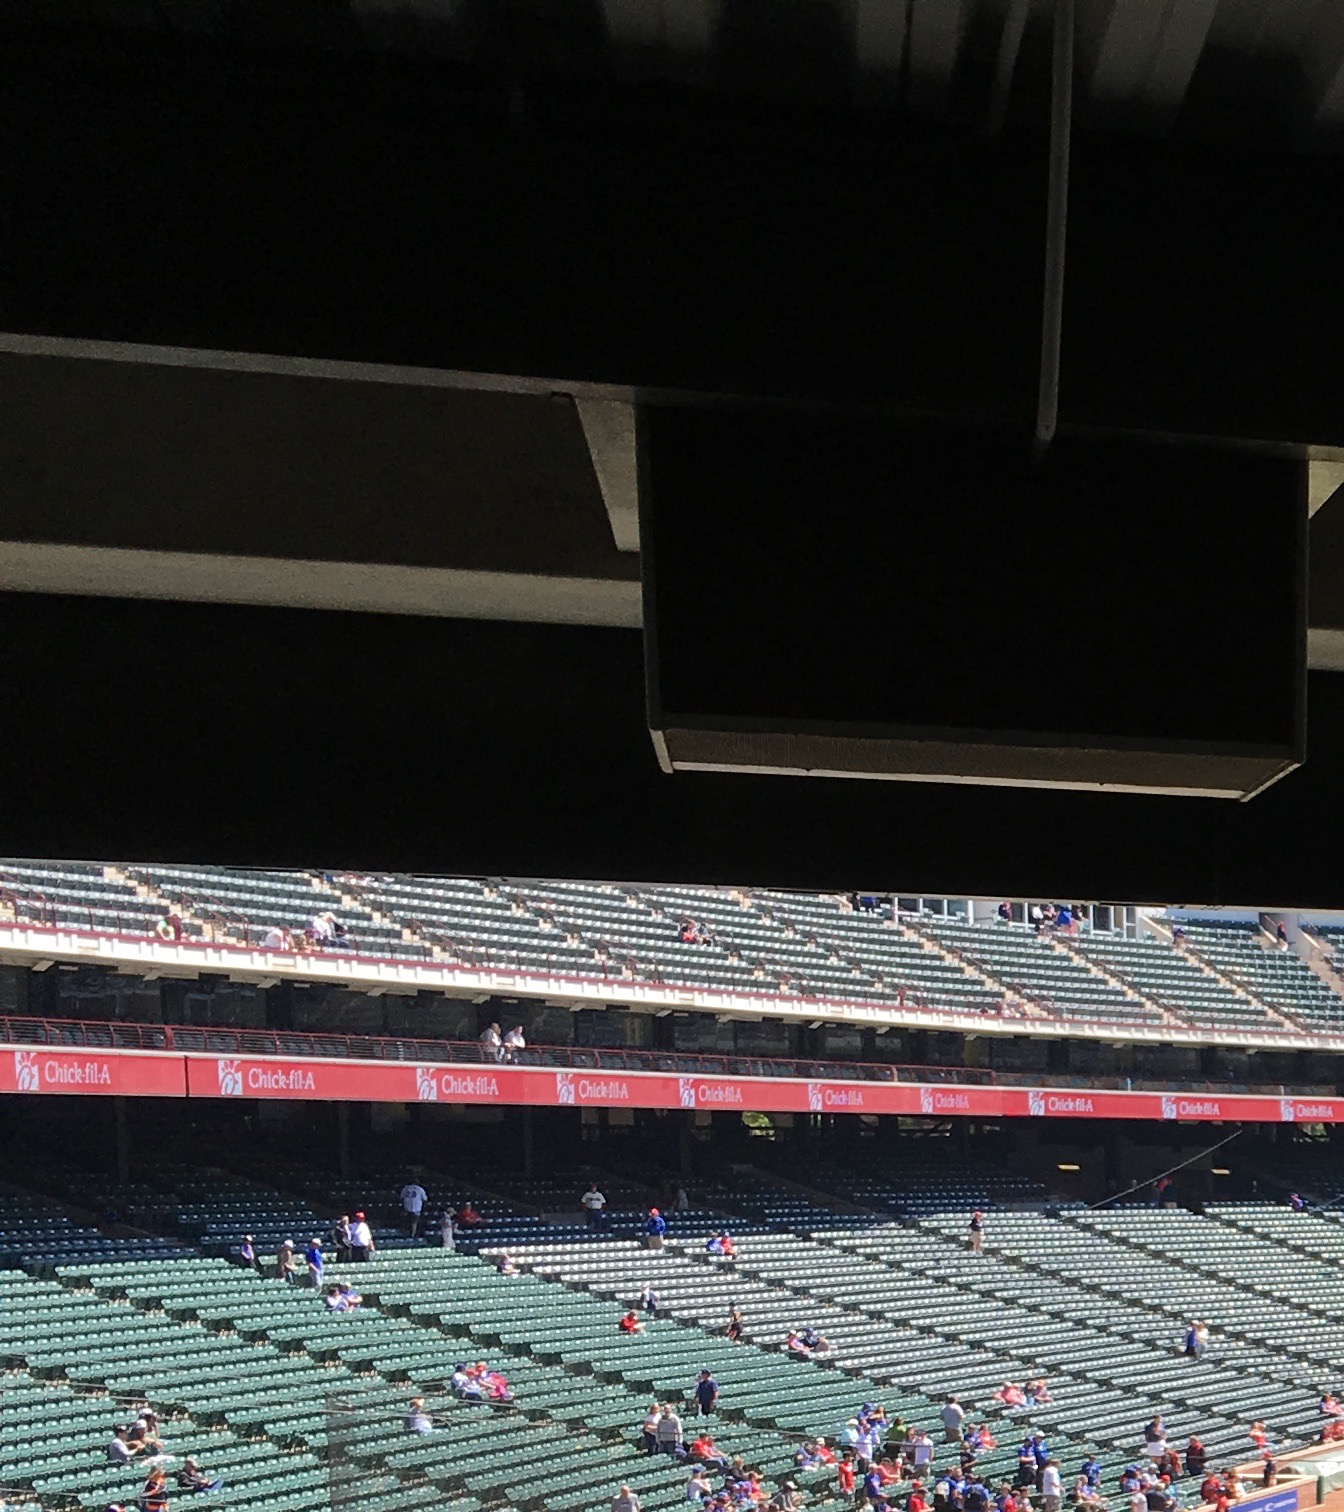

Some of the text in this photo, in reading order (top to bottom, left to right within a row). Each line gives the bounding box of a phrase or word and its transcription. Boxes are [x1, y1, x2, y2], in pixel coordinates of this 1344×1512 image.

[45, 1060, 111, 1084] Chick-fil-A
[249, 1067, 315, 1089] Chick-fil-A
[441, 1075, 499, 1096] Chick-fil-A
[578, 1080, 629, 1099] Chick-fil-A
[698, 1085, 743, 1103] Chick-fil-A
